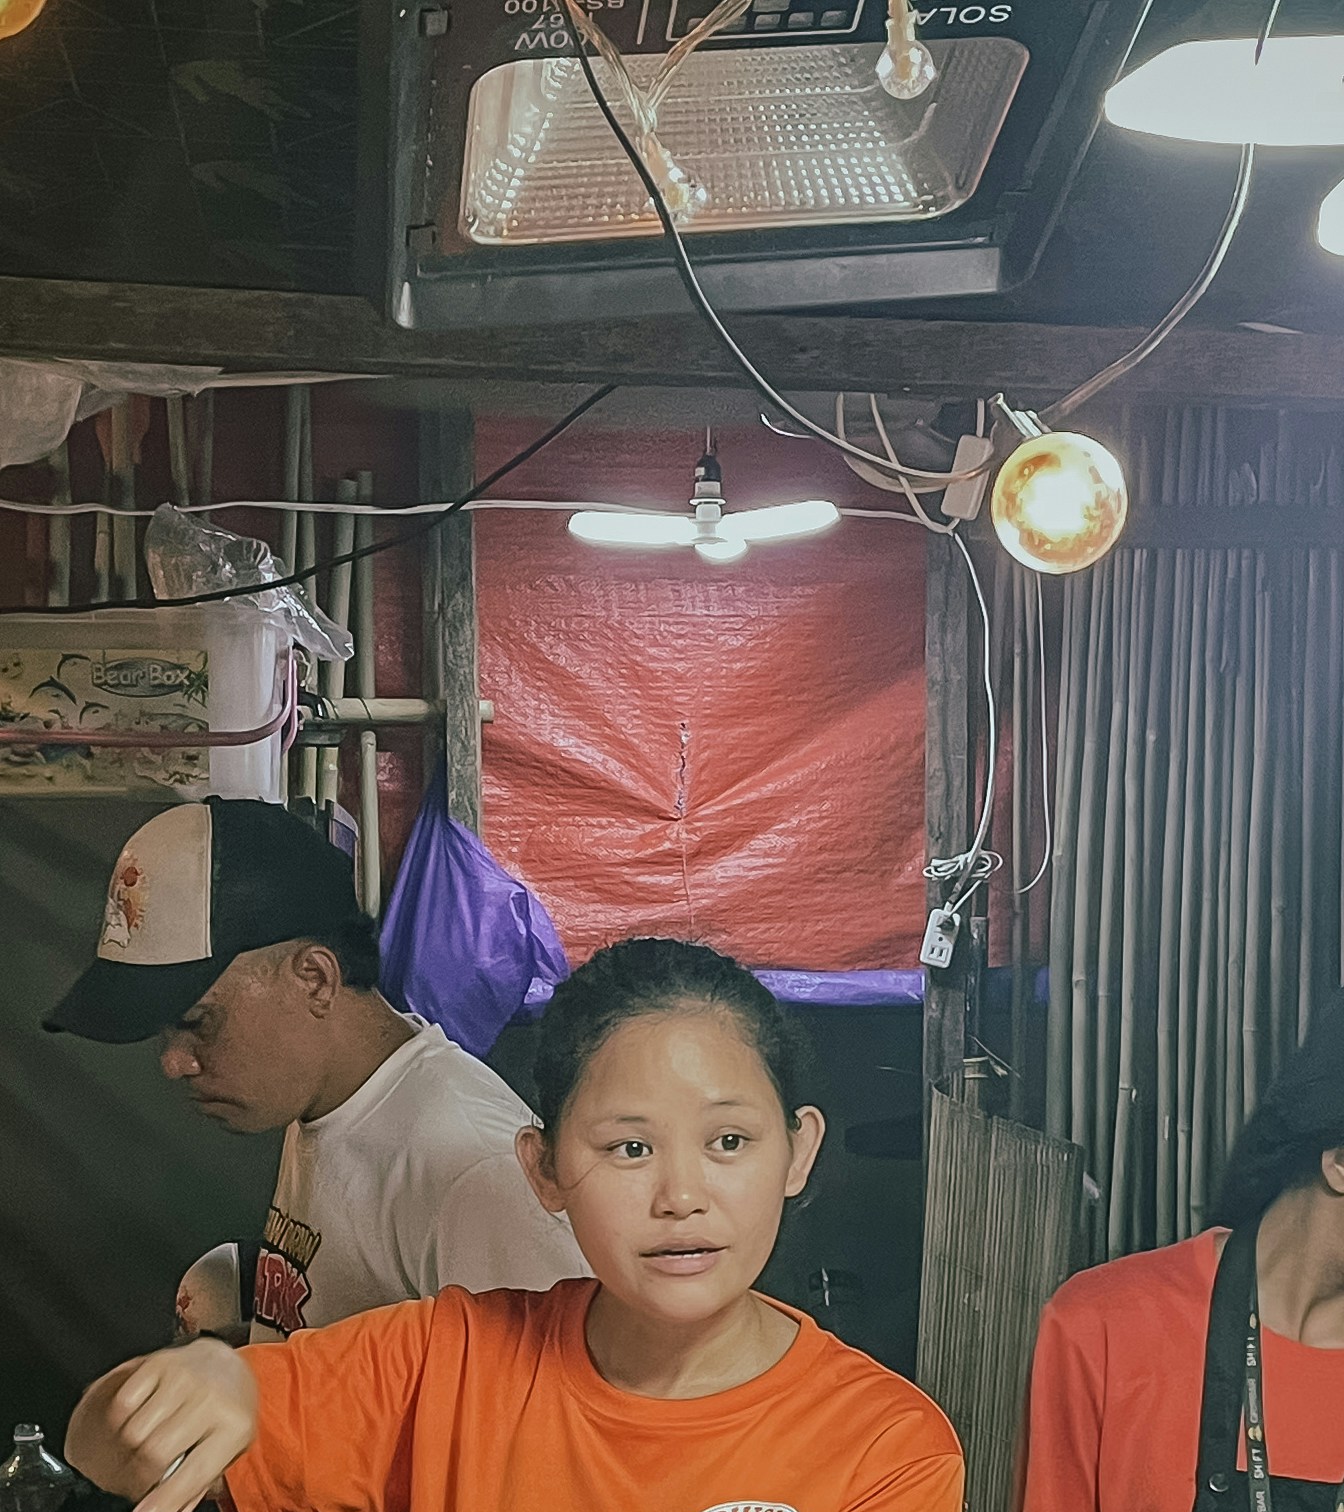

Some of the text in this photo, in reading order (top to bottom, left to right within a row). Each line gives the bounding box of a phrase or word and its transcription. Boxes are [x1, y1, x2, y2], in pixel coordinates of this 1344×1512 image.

[909, 4, 1013, 26] SOLA
[92, 663, 190, 686] Bear Box
